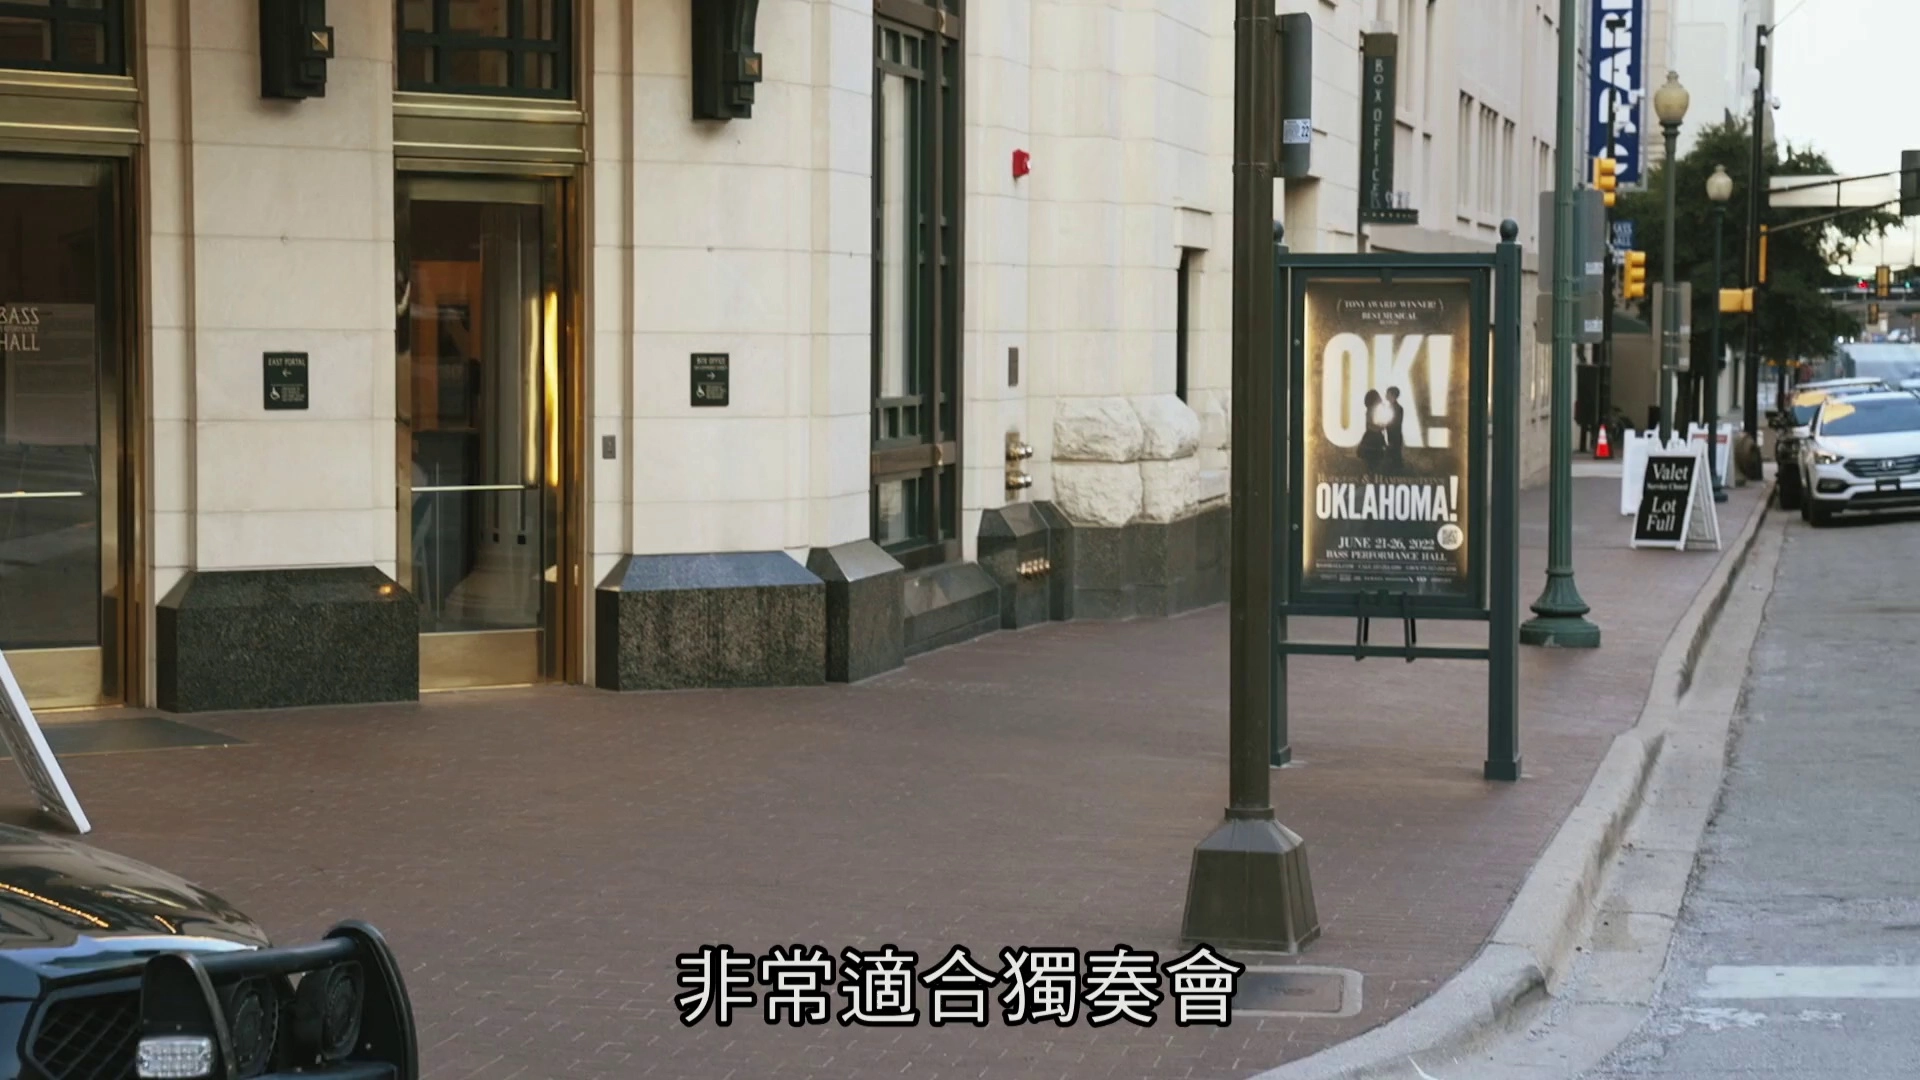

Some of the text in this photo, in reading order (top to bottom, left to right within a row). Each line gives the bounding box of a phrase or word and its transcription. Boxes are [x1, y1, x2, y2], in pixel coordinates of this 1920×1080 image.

[1598, 0, 1634, 124] PAR
[1371, 59, 1384, 191] BOX OFFICE
[1344, 300, 1365, 309] TONY
[1367, 300, 1397, 309] AWARD
[1362, 312, 1417, 320] BEST MUSICAL
[268, 358, 283, 366] EAST
[1322, 332, 1453, 448] OK!
[1653, 463, 1689, 480] Valet
[1316, 475, 1459, 522] OKLAHOMA!
[1651, 496, 1677, 513] Lot
[1646, 513, 1676, 532] Full
[1338, 536, 1435, 551] JUNE 21-26, 2022
[1326, 549, 1448, 561] BASS PERFORMANCE HALL
